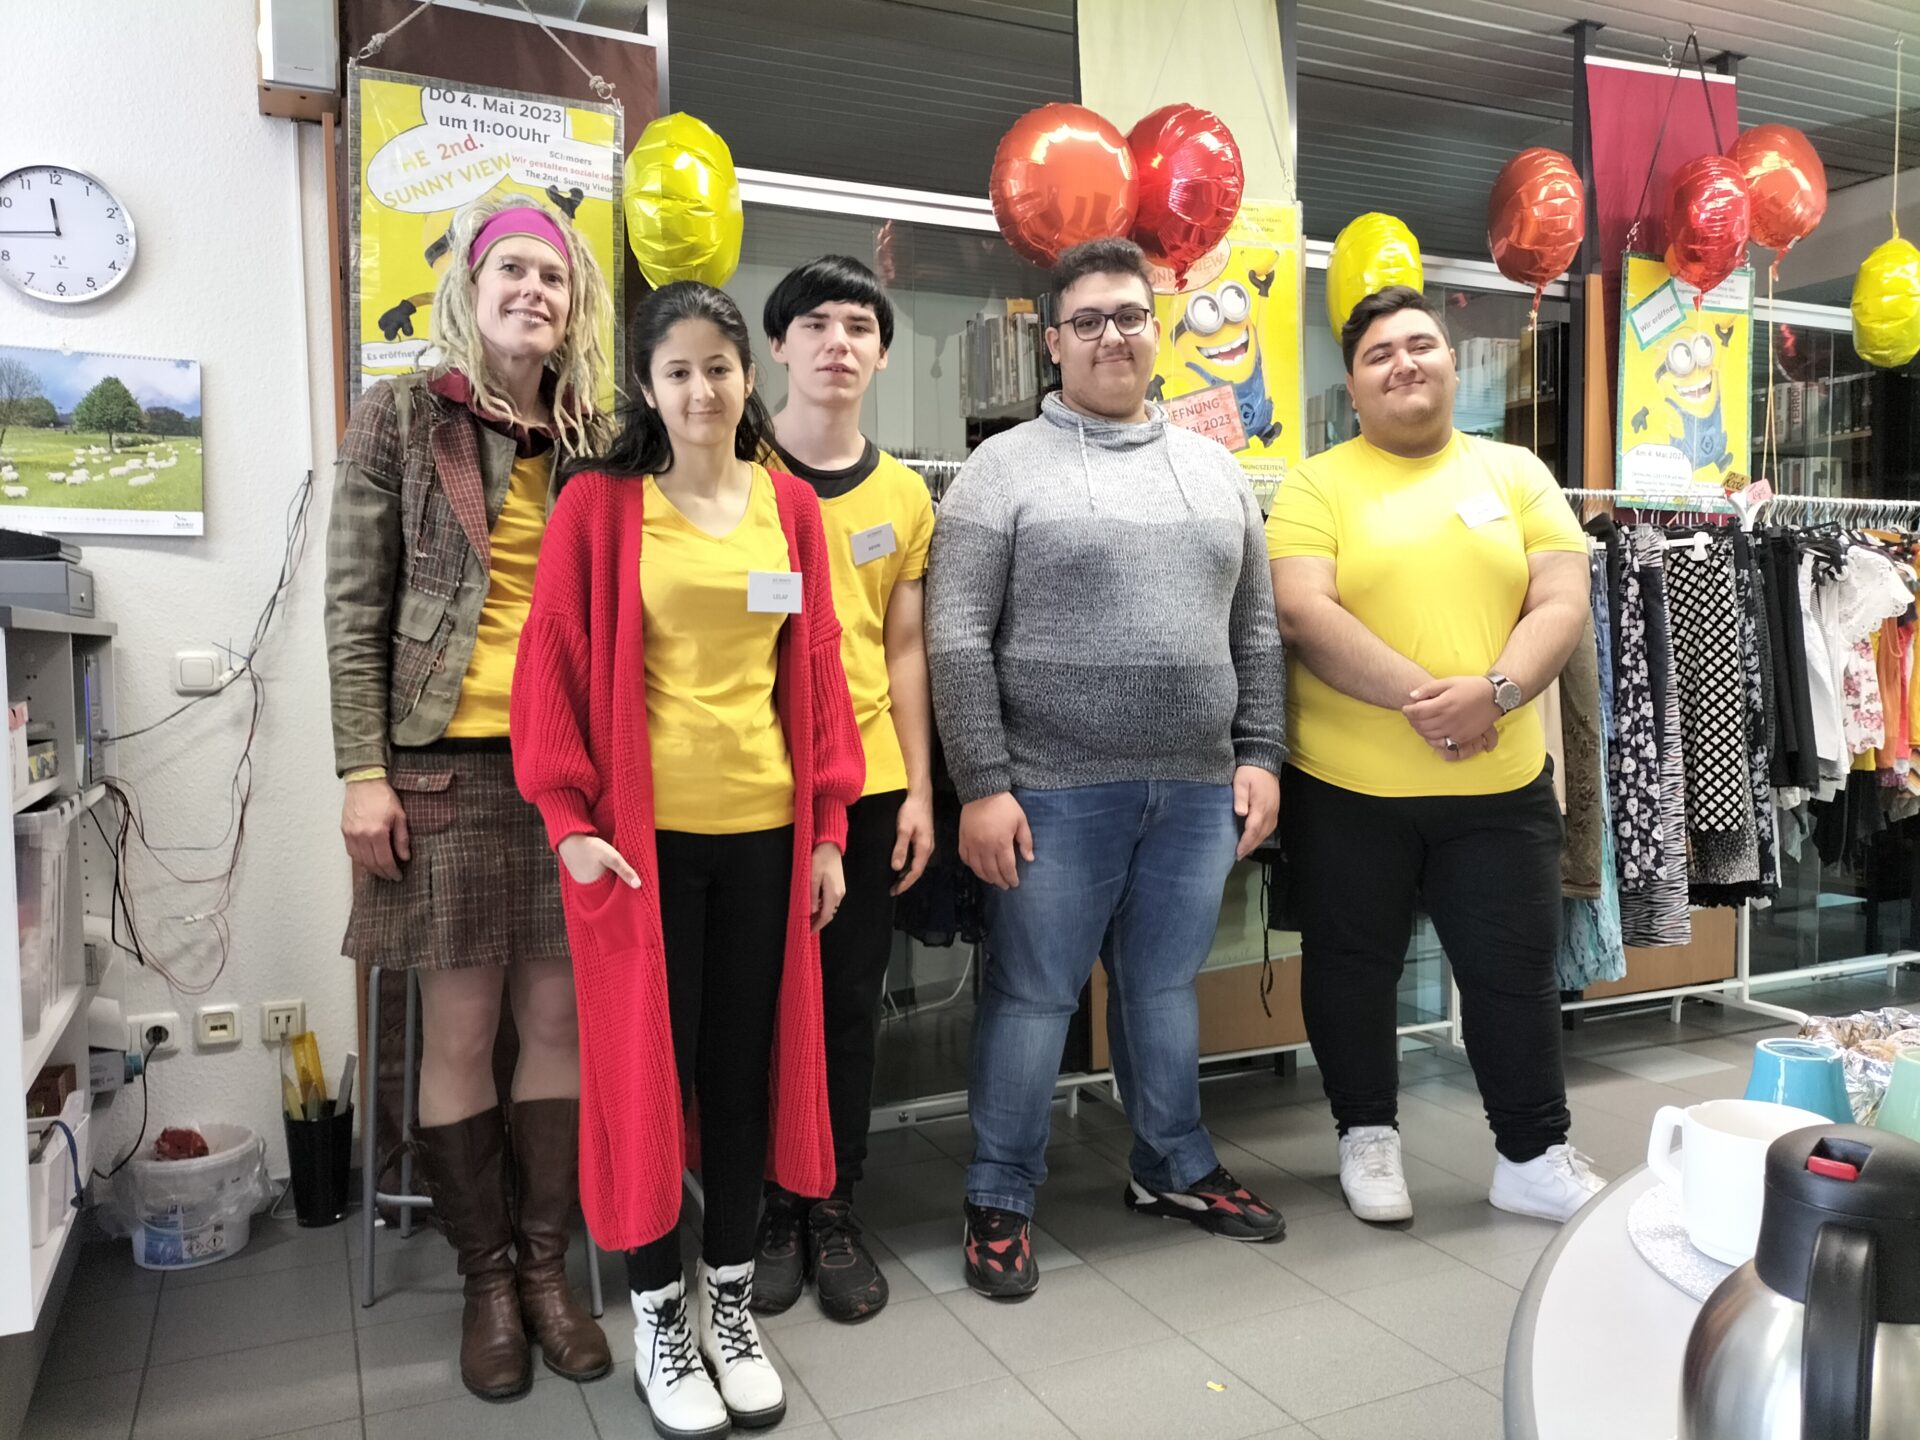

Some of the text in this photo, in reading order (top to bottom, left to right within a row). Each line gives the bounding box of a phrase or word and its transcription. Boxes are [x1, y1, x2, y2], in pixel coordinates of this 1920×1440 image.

[483, 97, 515, 115] Mai
[519, 104, 562, 123] 2023
[439, 115, 551, 144] um 11:00Uhr
[437, 133, 484, 161] 2nd.
[511, 154, 527, 165] Wir
[49, 173, 62, 186] 12
[525, 168, 542, 179] The
[20, 178, 31, 191] 11
[383, 152, 512, 209] SUNNY VIEW
[106, 207, 116, 219] 2
[115, 233, 125, 245] 3
[1, 249, 11, 262] 8
[107, 260, 117, 271] 4
[26, 271, 36, 283] 7
[86, 276, 96, 289] 5
[56, 281, 67, 293] 6
[1168, 397, 1220, 422] FFNUNG
[1203, 413, 1232, 431] 2023
